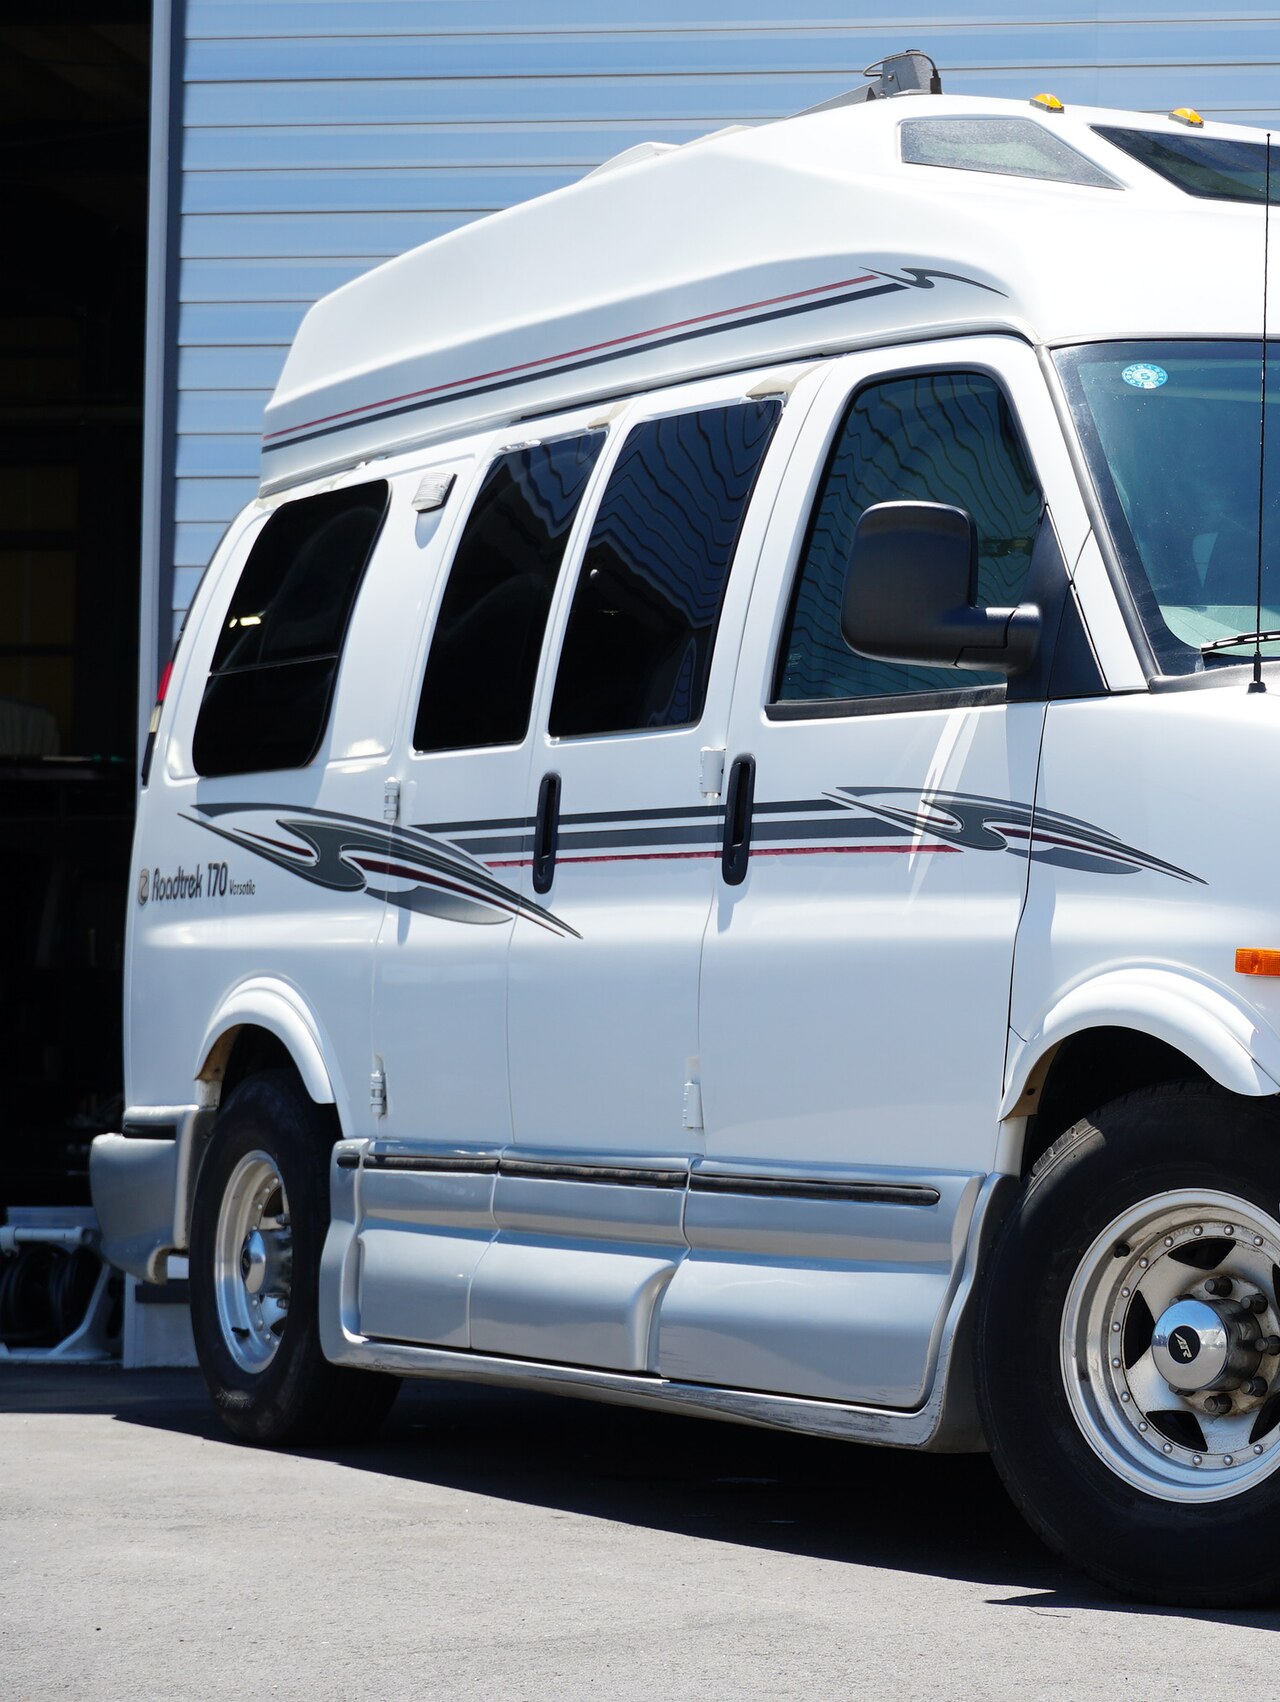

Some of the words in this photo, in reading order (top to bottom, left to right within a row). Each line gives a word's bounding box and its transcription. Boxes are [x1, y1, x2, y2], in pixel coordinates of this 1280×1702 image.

[1140, 372, 1151, 380] 5
[151, 863, 203, 901] Roadtrek
[207, 862, 228, 897] 170
